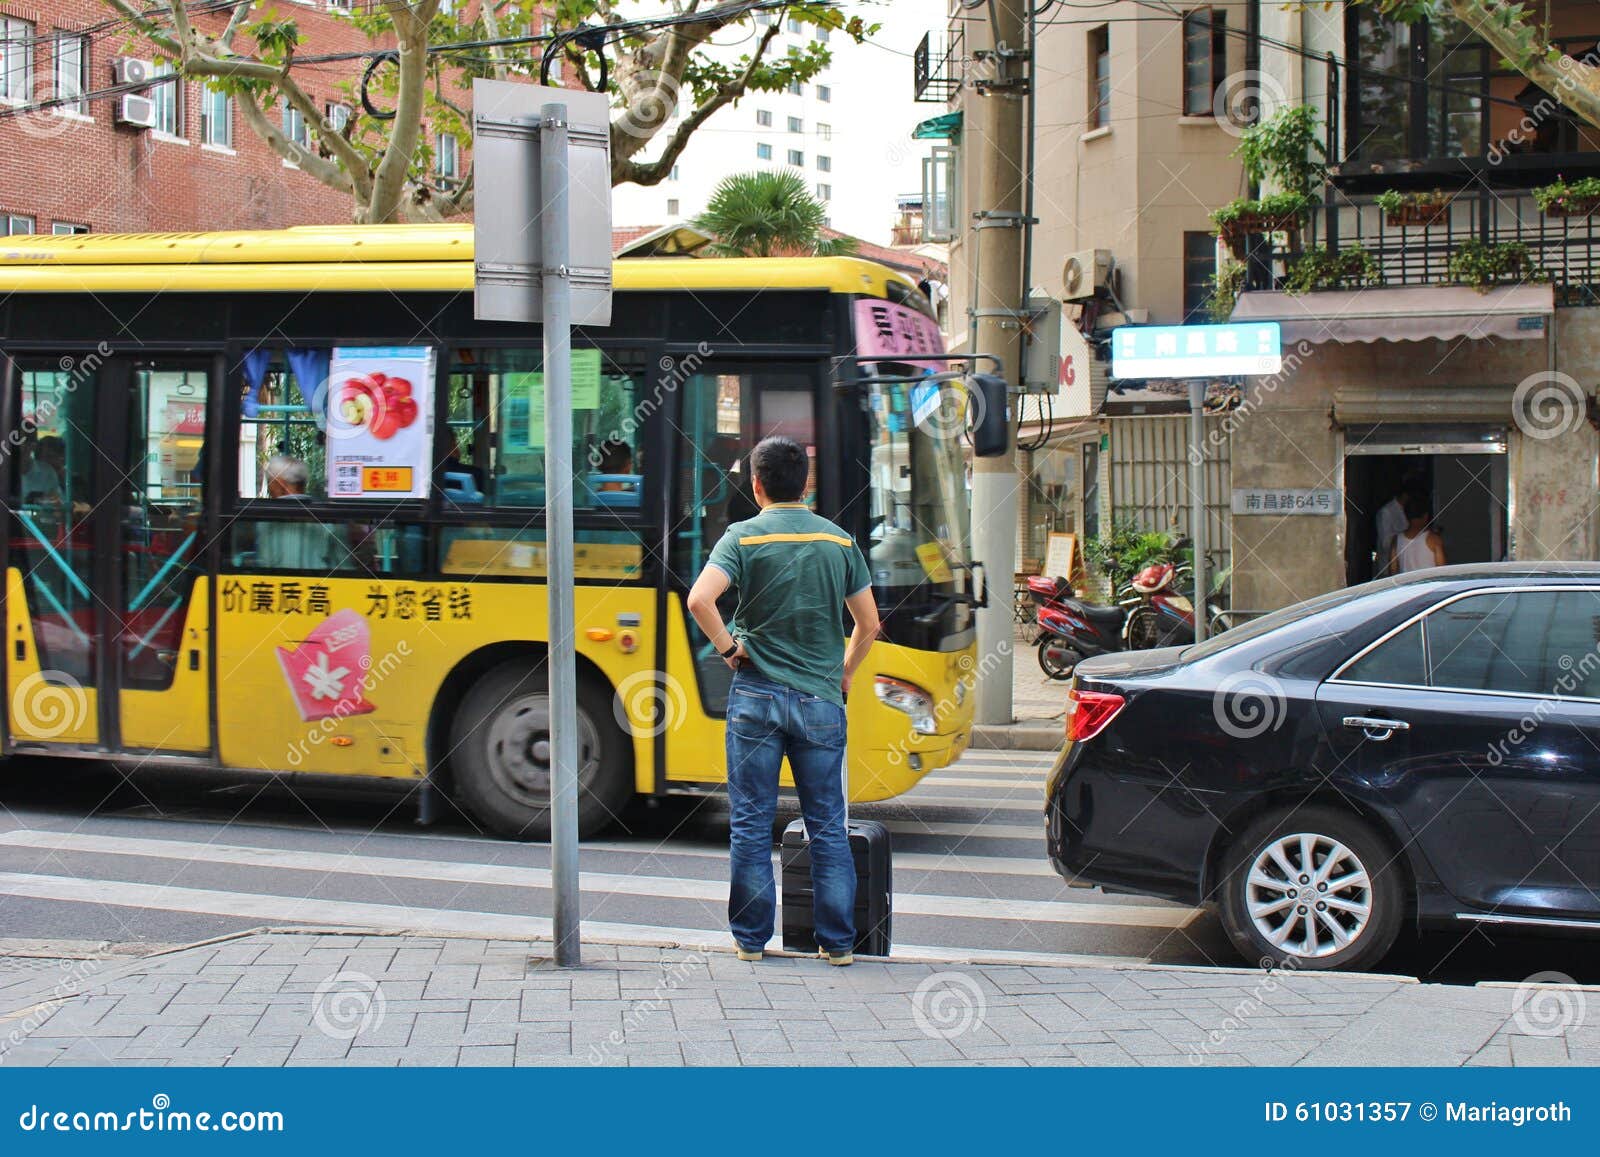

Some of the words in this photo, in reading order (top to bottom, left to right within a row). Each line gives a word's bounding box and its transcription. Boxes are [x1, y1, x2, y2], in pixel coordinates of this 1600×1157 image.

[1246, 493, 1331, 510] 南昌路64号
[222, 580, 330, 616] 价廉质高
[366, 585, 472, 620] 为您省钱
